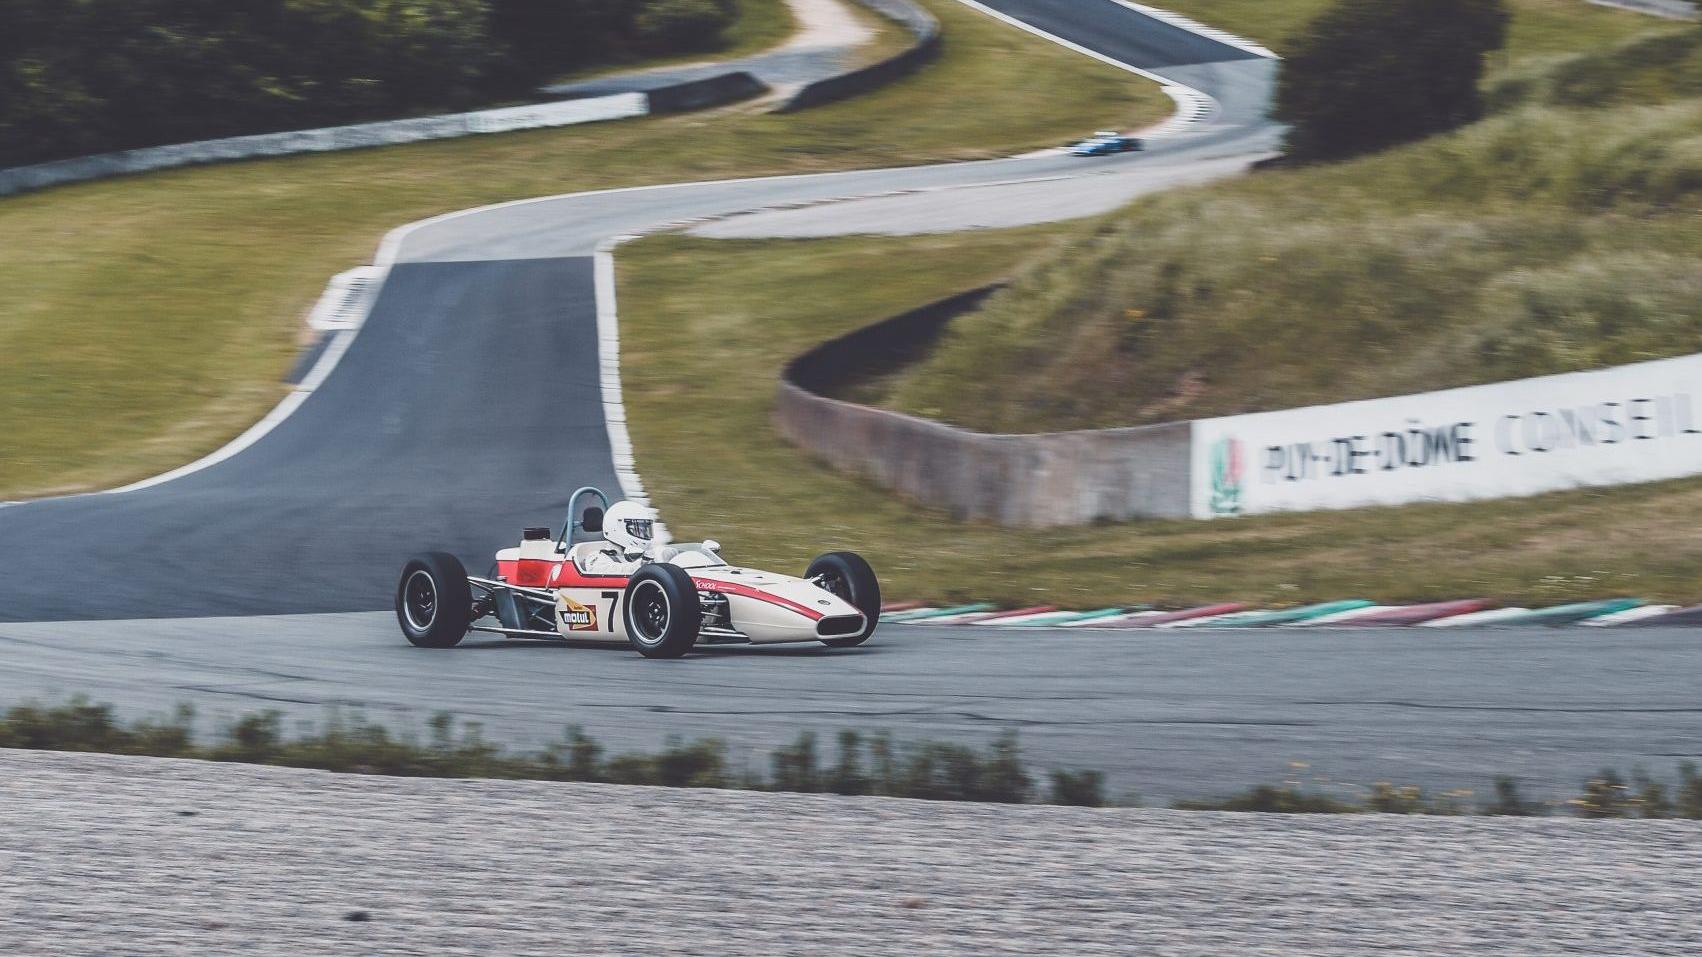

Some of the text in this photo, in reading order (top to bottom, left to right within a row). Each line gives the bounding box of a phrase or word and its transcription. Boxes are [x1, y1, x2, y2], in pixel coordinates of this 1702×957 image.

[1495, 392, 1702, 455] CONSEIL
[563, 612, 590, 624] motul
[601, 592, 619, 632] 7
